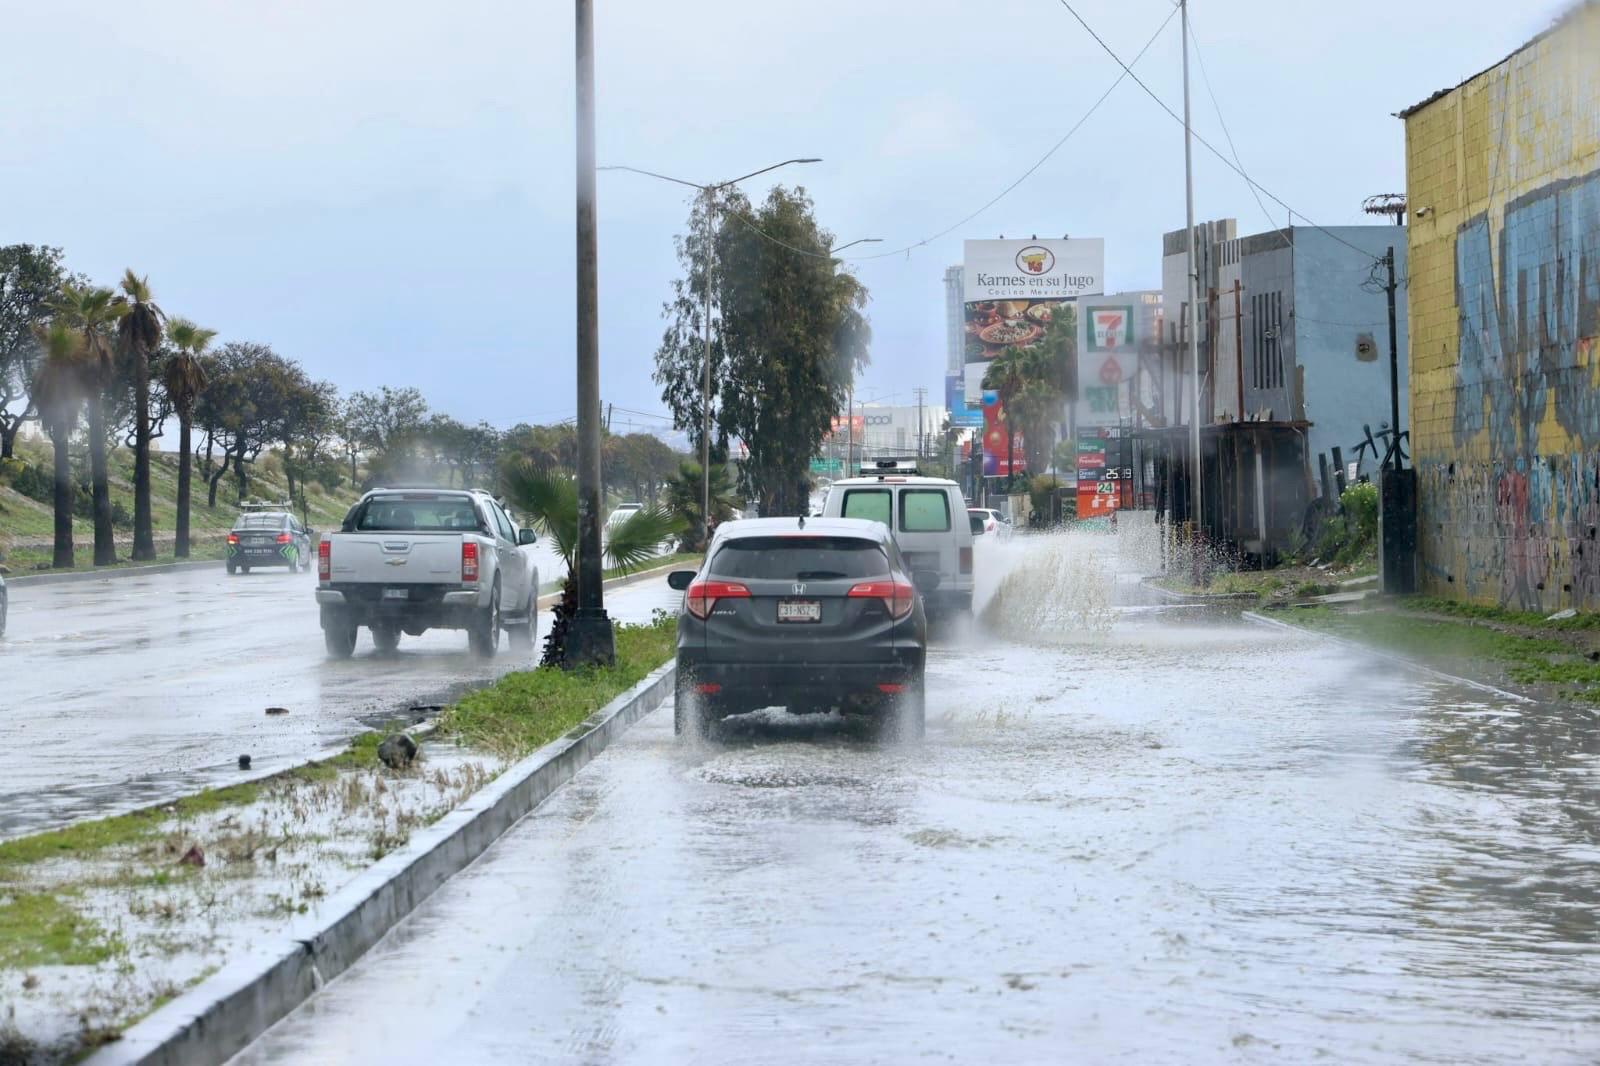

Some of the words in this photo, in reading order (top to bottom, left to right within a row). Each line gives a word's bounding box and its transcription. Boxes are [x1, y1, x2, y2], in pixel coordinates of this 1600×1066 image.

[977, 273, 1026, 287] Karnes
[1029, 277, 1043, 287] en
[1046, 277, 1060, 287] su
[1063, 273, 1094, 289] Jugo
[1098, 482, 1113, 493] 24
